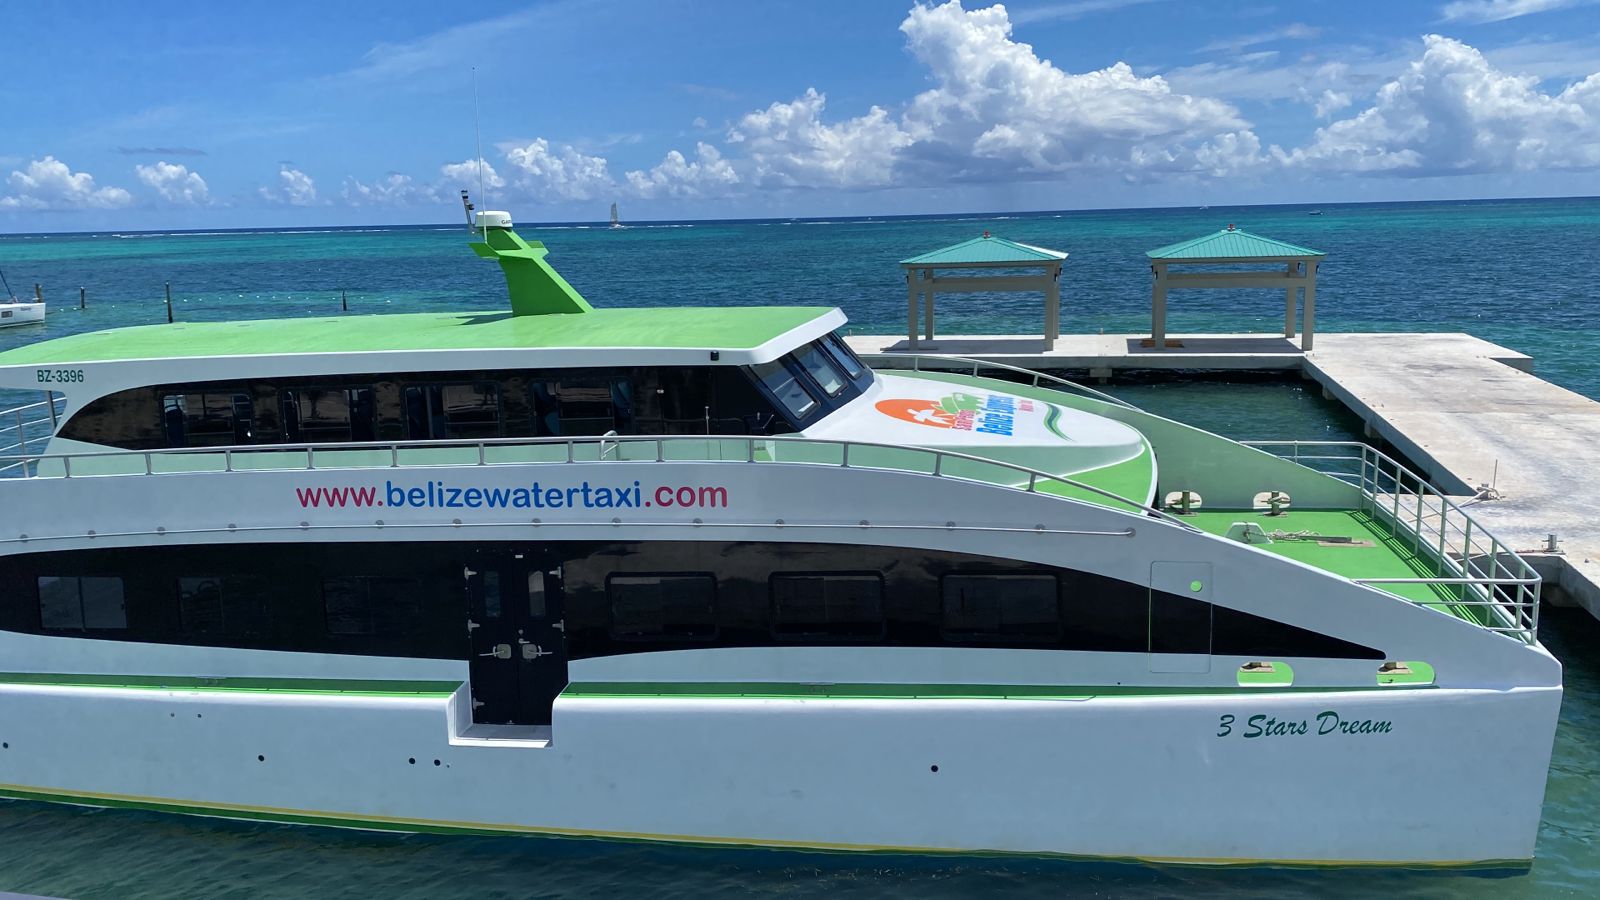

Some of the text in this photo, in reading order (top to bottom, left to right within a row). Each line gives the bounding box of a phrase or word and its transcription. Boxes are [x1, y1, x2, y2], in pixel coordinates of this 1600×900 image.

[37, 369, 84, 383] BZ-3396
[976, 412, 1013, 436] Belize
[296, 481, 728, 508] www.belizewatertaxi.com
[1217, 711, 1392, 738] 3 Stars Dream
